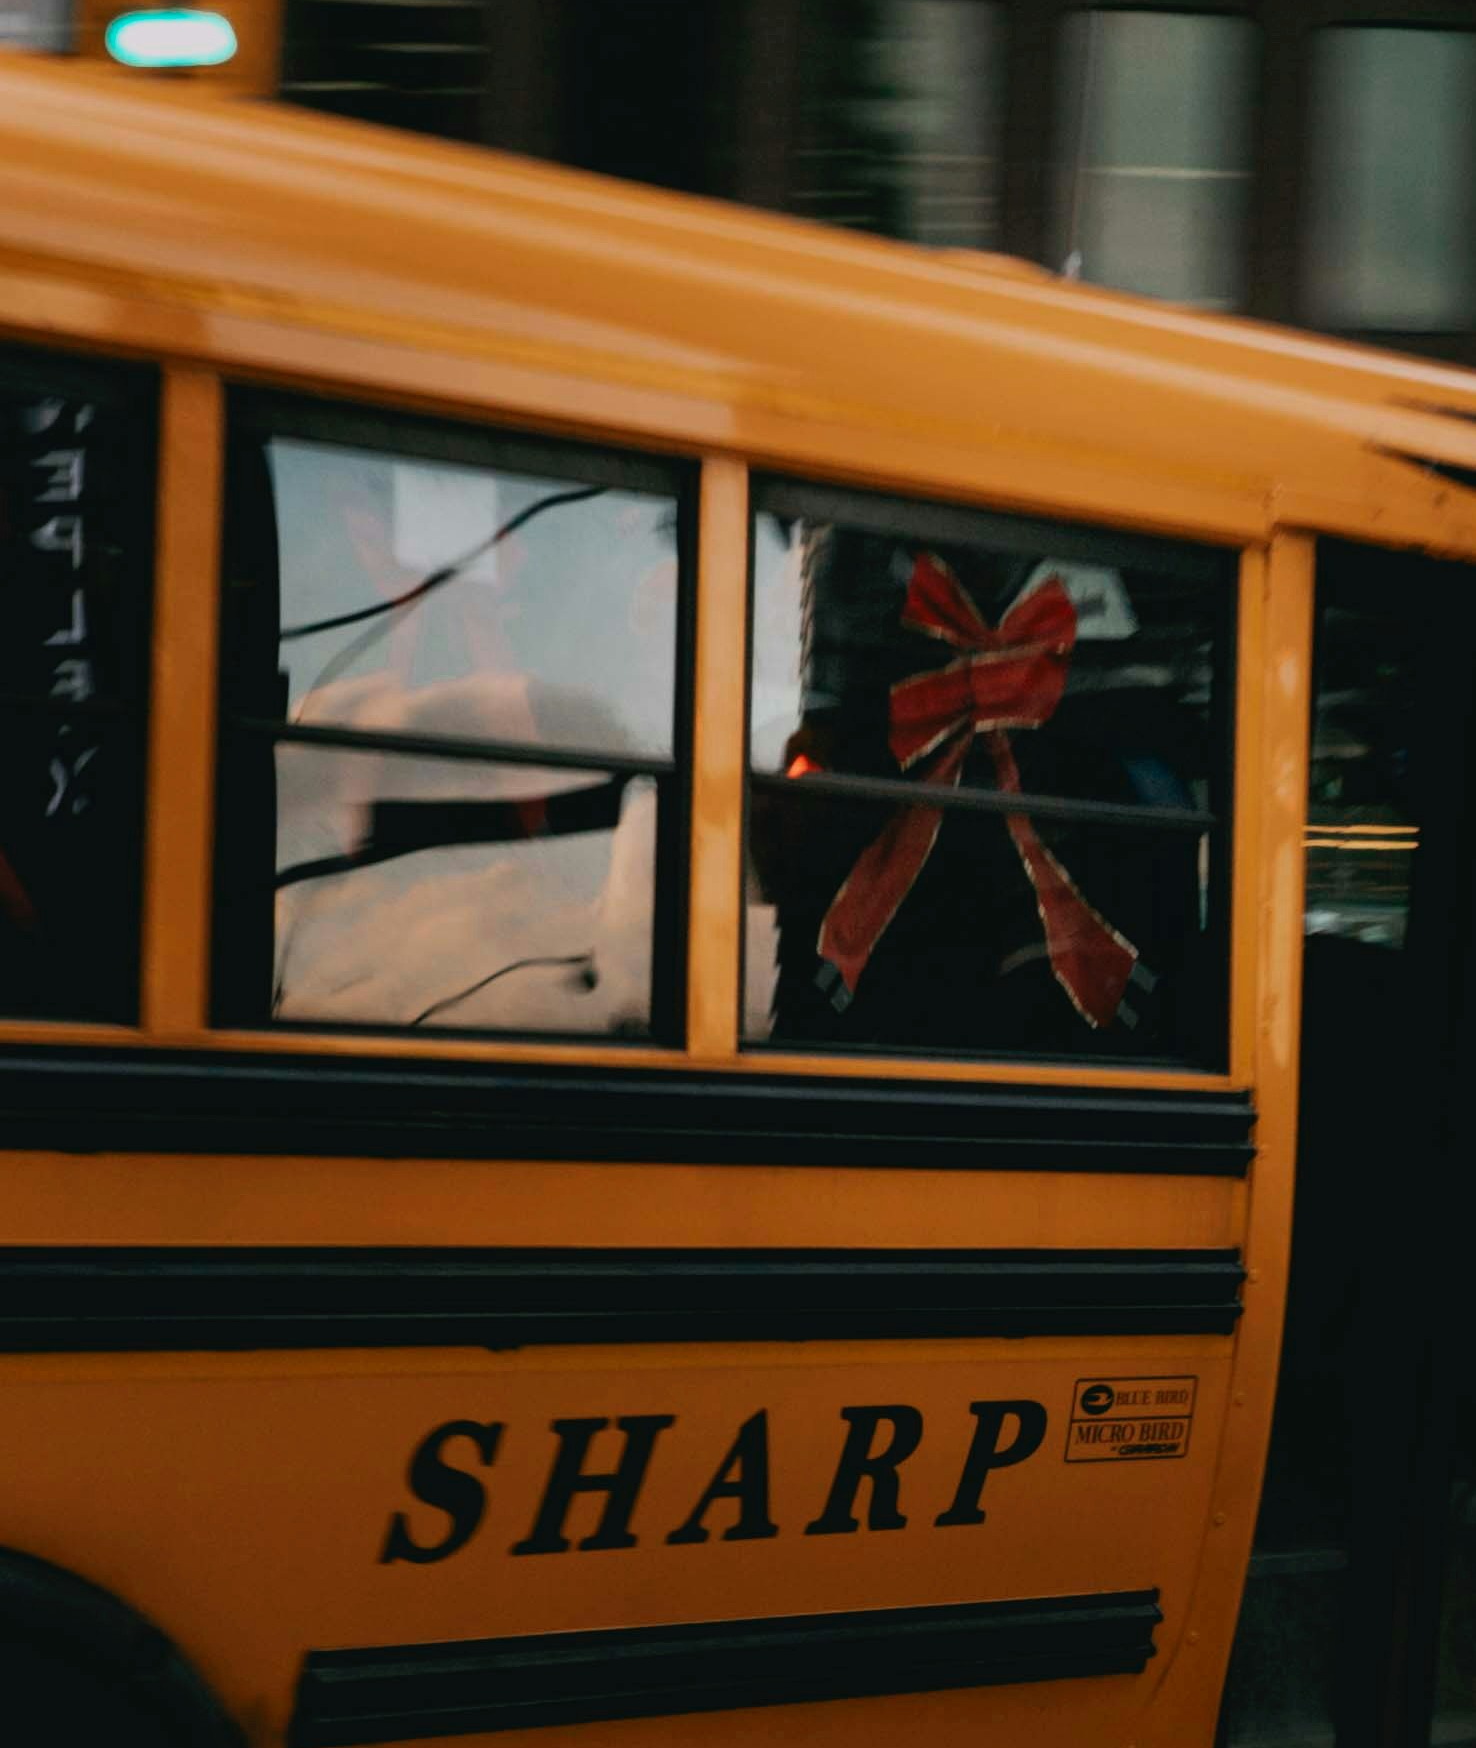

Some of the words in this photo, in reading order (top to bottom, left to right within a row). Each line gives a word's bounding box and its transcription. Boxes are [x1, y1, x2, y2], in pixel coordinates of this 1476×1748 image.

[1115, 1391, 1150, 1405] BLUE
[1155, 1389, 1189, 1404] BIRD
[1075, 1424, 1135, 1444] MICRO
[1139, 1421, 1184, 1441] BIRD
[376, 1401, 1048, 1563] SHARP
